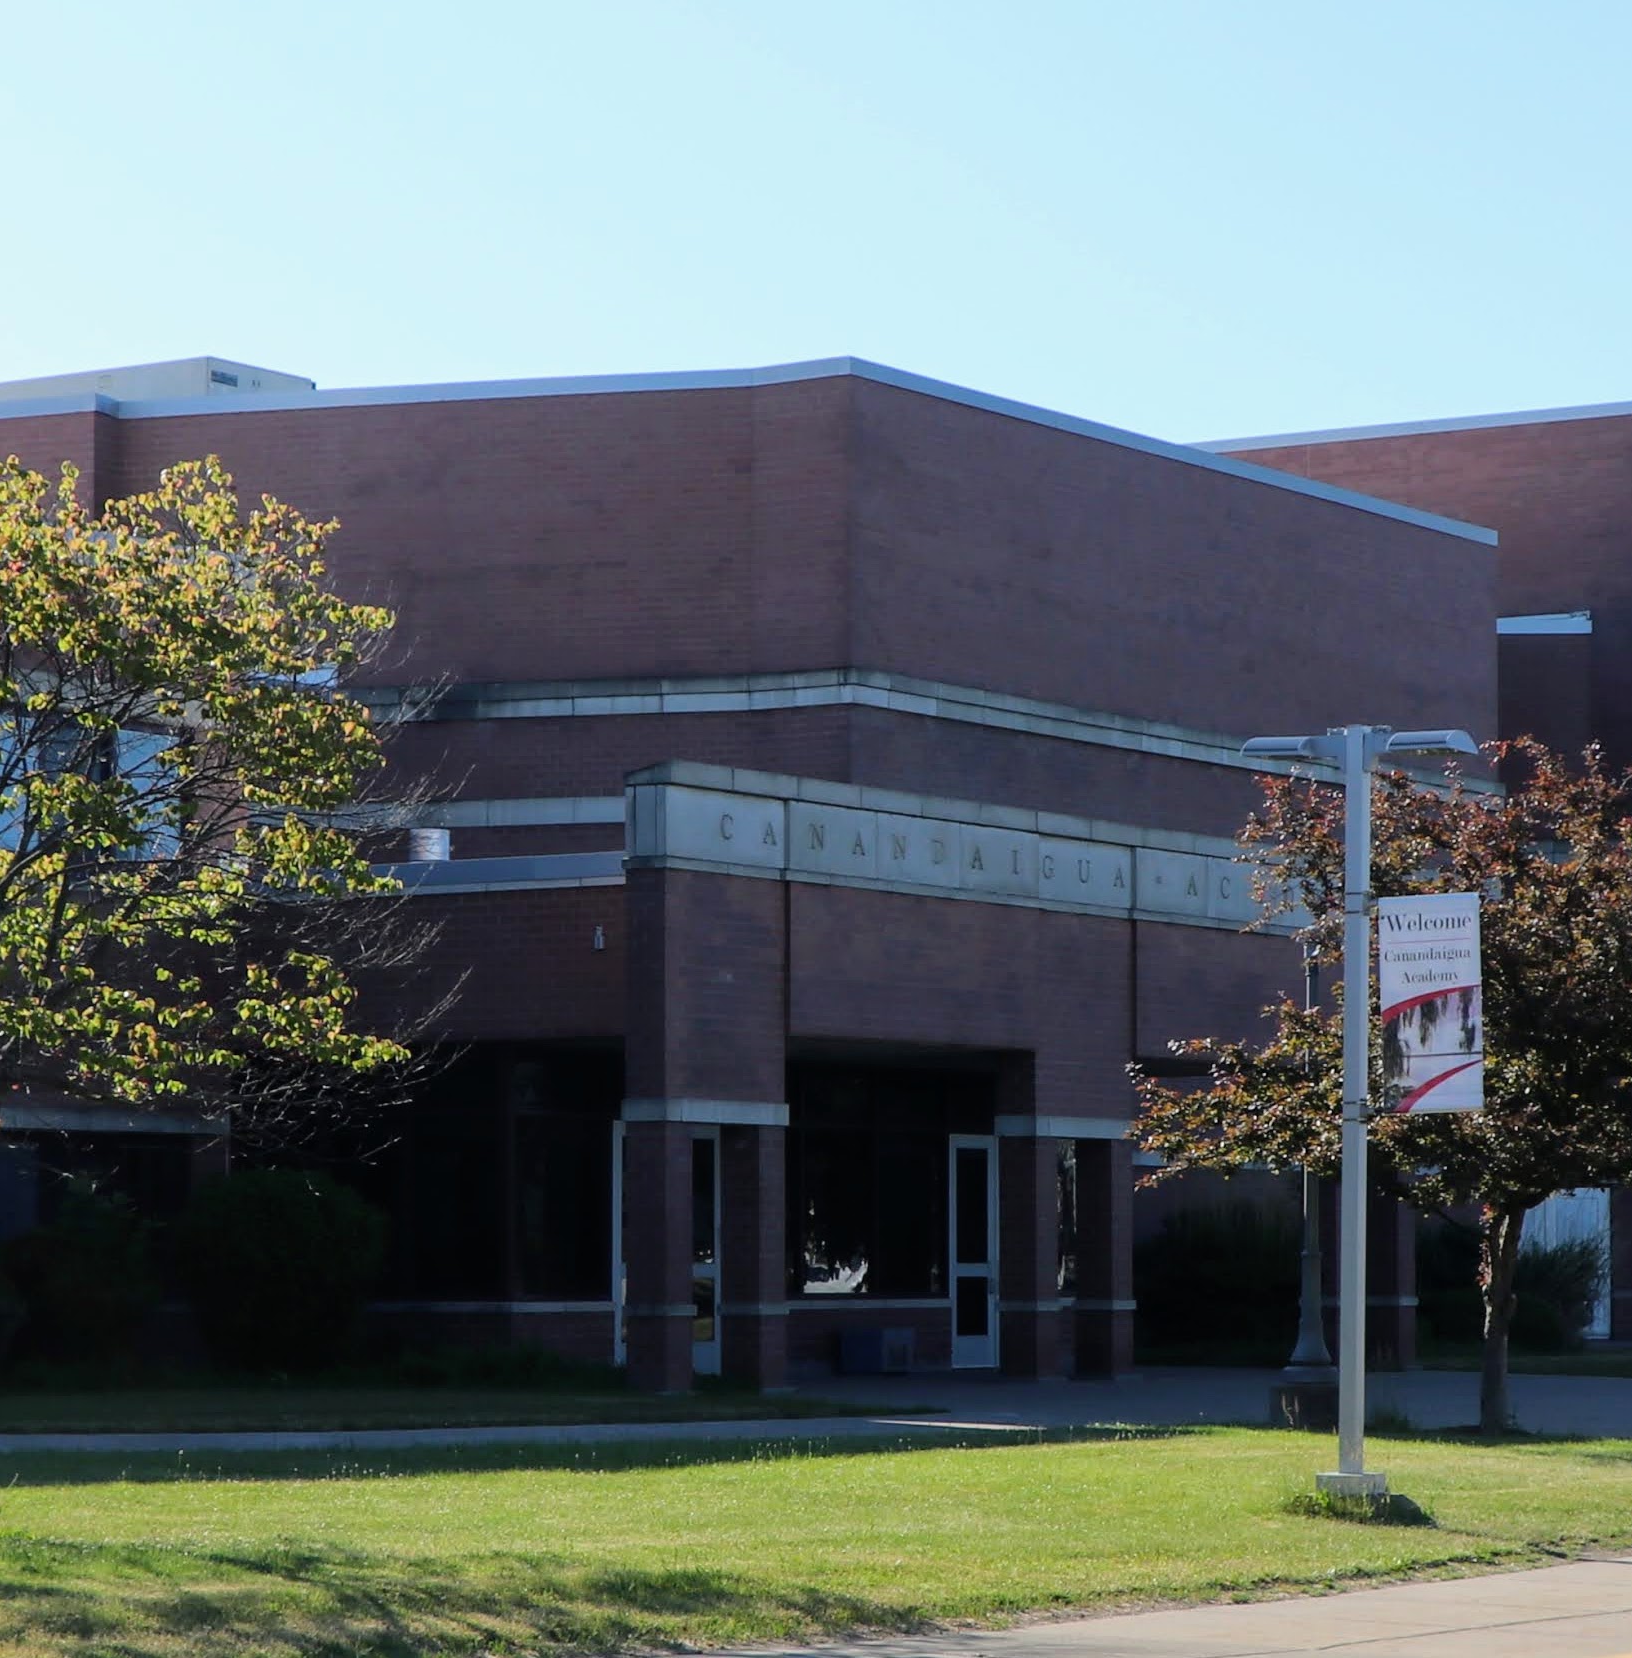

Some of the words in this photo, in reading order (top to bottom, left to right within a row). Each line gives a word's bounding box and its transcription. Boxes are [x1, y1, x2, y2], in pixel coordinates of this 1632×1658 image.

[720, 813, 1125, 889] CANANDAIGUA
[1381, 913, 1471, 932] Welcome
[1384, 946, 1471, 962] Canandaigua
[1401, 969, 1459, 984] Academy
